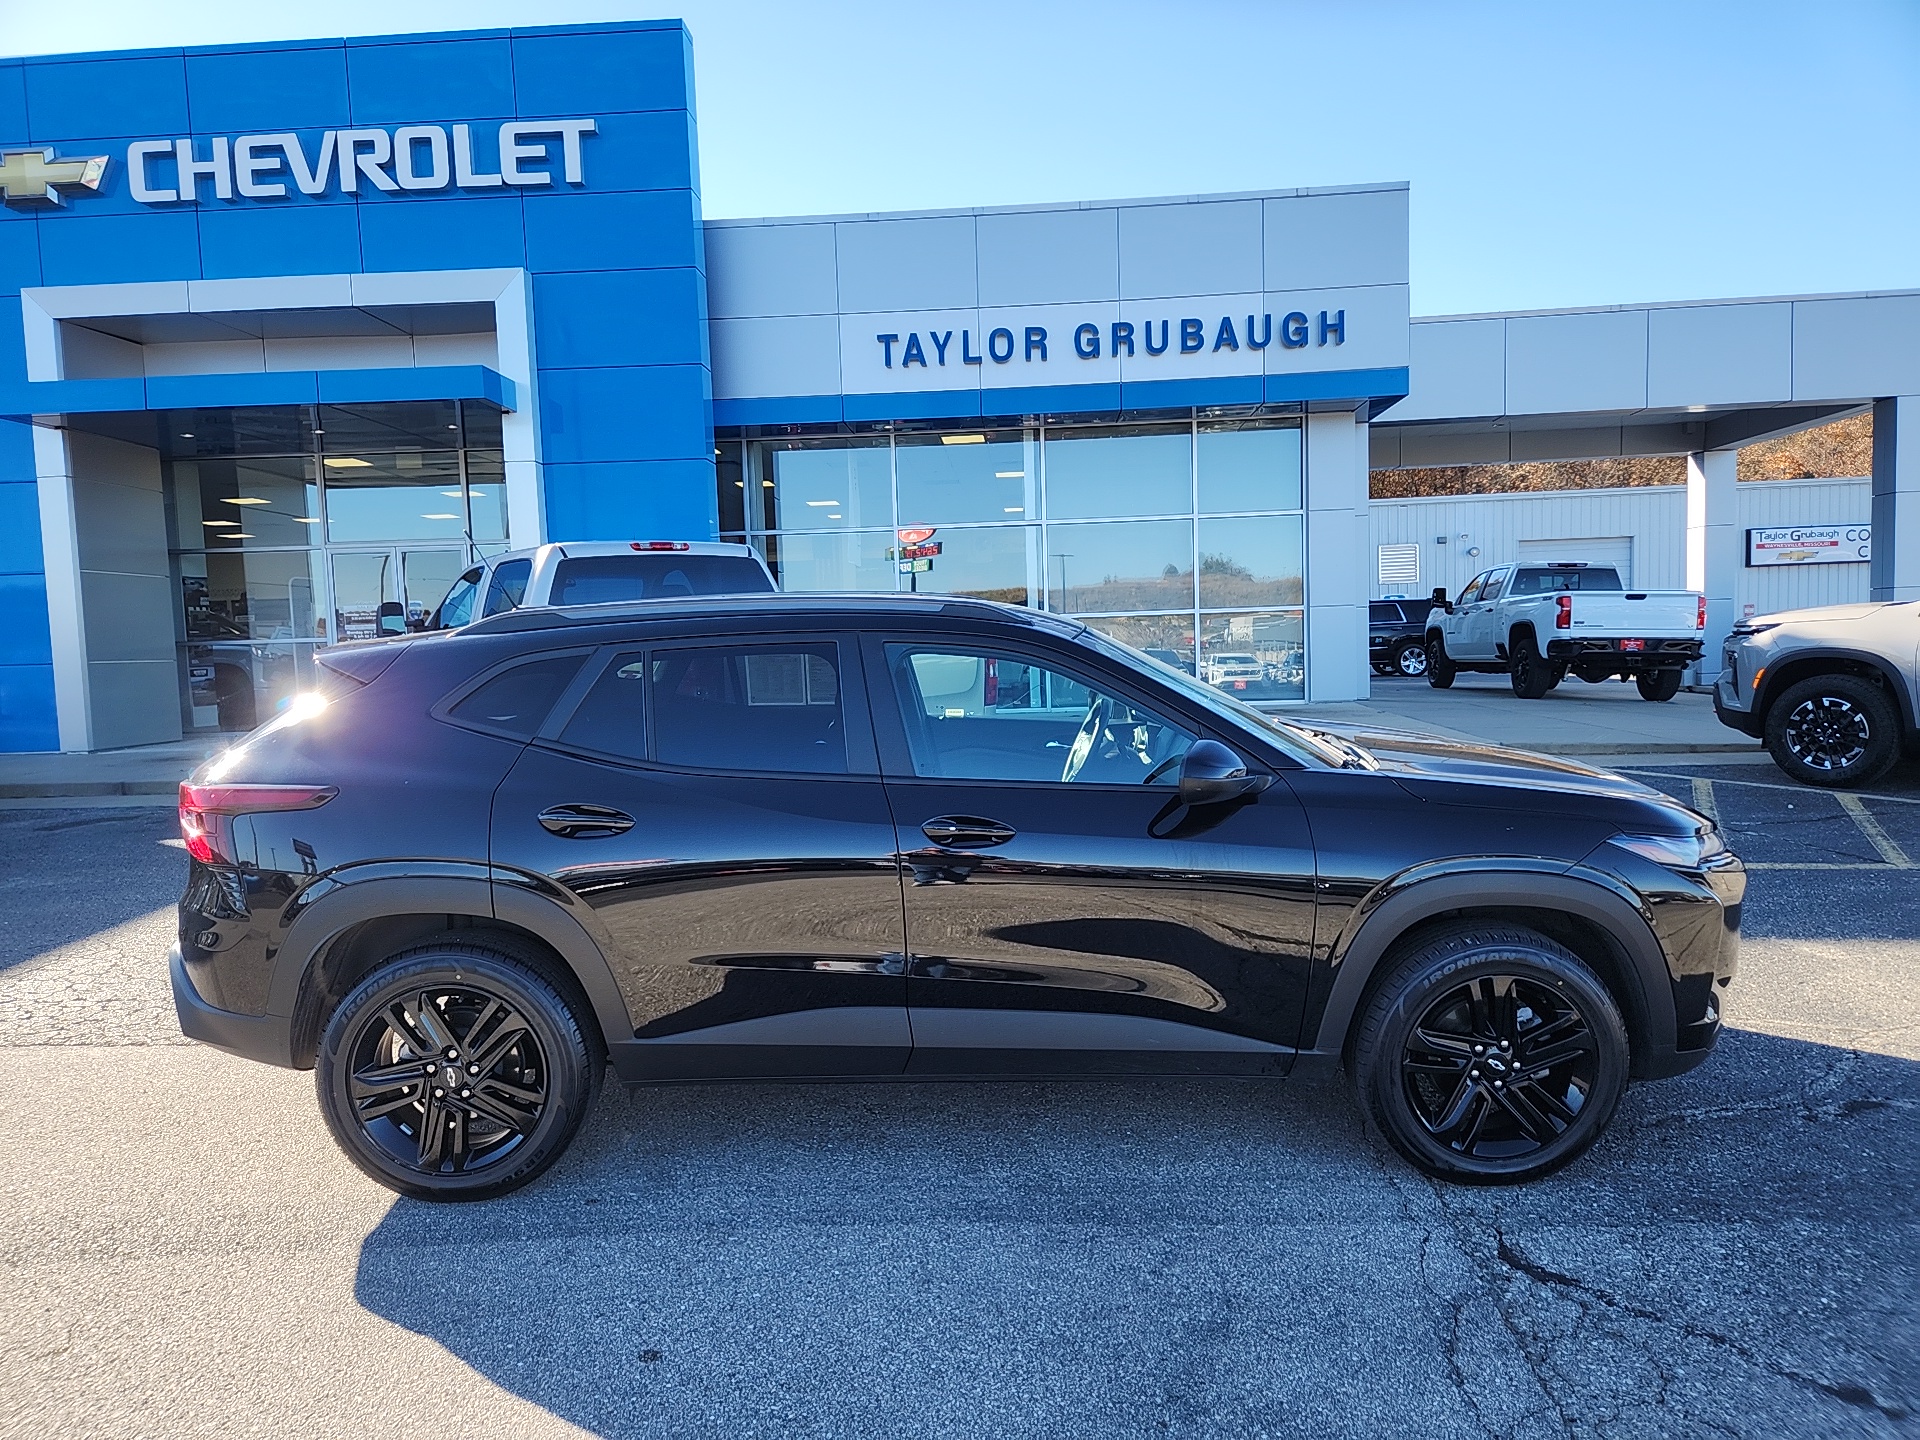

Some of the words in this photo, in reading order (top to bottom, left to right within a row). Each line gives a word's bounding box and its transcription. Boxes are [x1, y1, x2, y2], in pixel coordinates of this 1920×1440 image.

[127, 118, 597, 204] CHEVROLET
[877, 326, 1048, 368] TAYLOR
[1073, 309, 1346, 360] GRUBAUGH
[1756, 531, 1788, 542] Taylor
[1790, 529, 1839, 541] Grubaugh
[340, 964, 425, 1025] IRONMAN
[1422, 952, 1517, 989] IRONMAN
